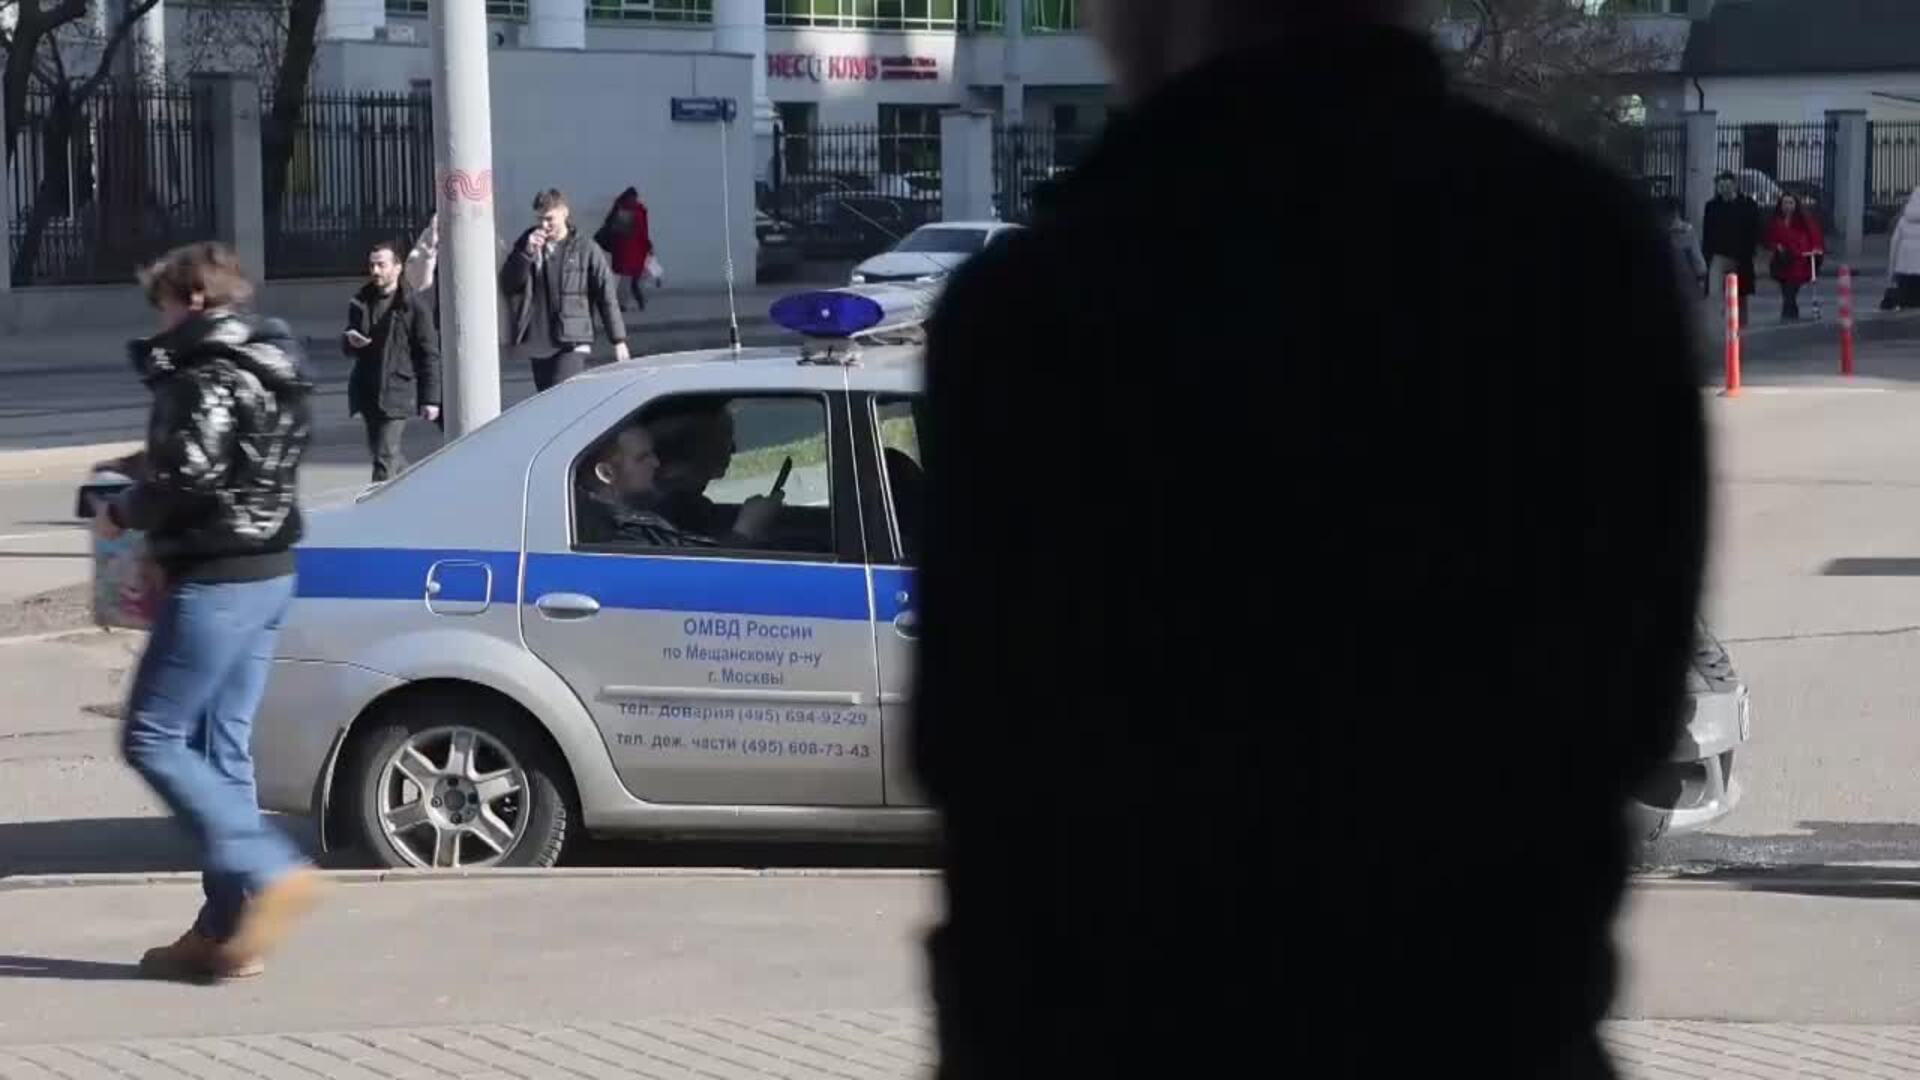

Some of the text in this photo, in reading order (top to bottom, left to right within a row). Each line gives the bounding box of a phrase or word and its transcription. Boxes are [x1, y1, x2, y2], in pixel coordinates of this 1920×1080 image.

[828, 55, 878, 80] КЛУБ
[683, 618, 813, 640] ОМВД России
[663, 645, 822, 668] по Мещанскому р-ну
[708, 668, 783, 685] г. Москвы
[739, 707, 780, 724] (495)
[691, 736, 736, 750] части
[742, 739, 783, 756] (495)
